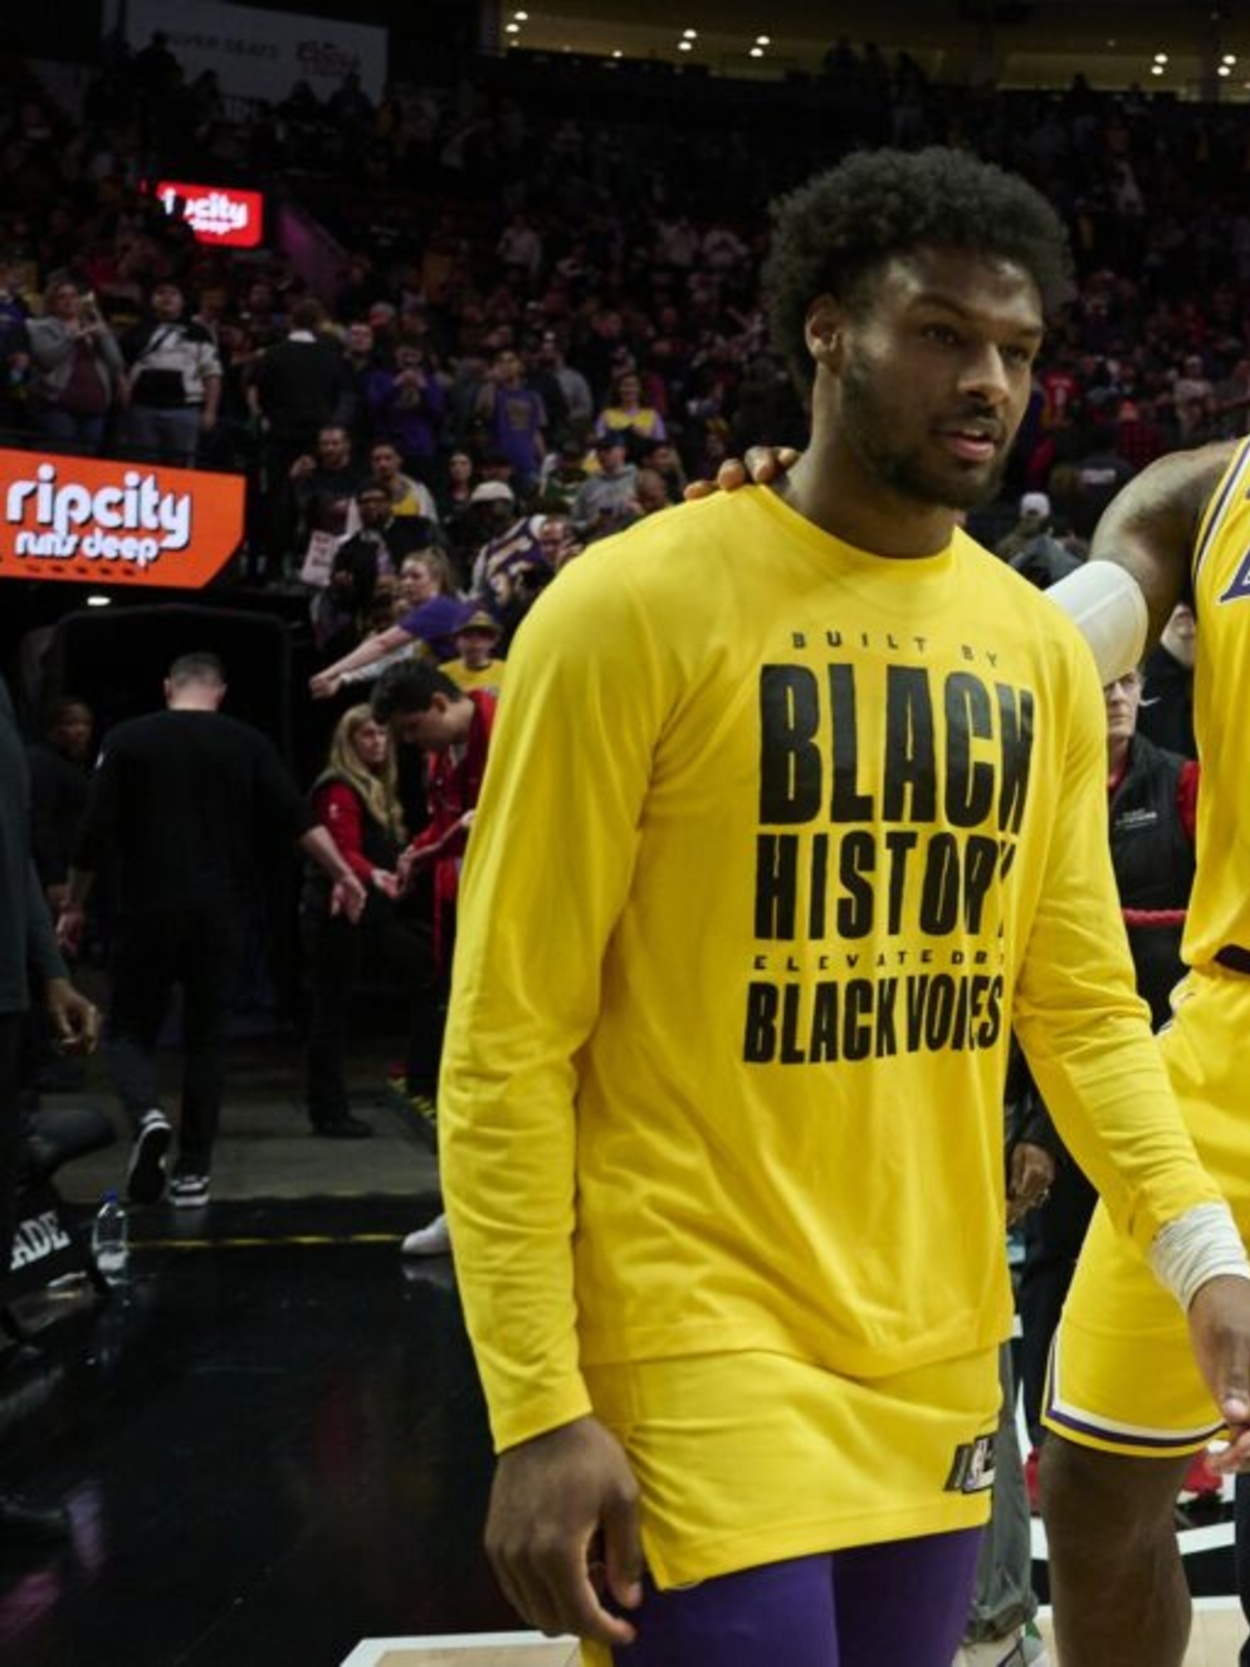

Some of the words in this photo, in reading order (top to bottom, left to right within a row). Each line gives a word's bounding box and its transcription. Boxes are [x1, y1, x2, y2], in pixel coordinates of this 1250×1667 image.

[6, 463, 191, 550] ripcity
[15, 531, 79, 559] runs
[82, 527, 159, 568] deep
[792, 630, 927, 653] BUILT
[961, 644, 998, 667] BY
[758, 662, 1035, 834] BLACK
[743, 977, 899, 1065] BLACK
[905, 972, 1004, 1054] VOIES
